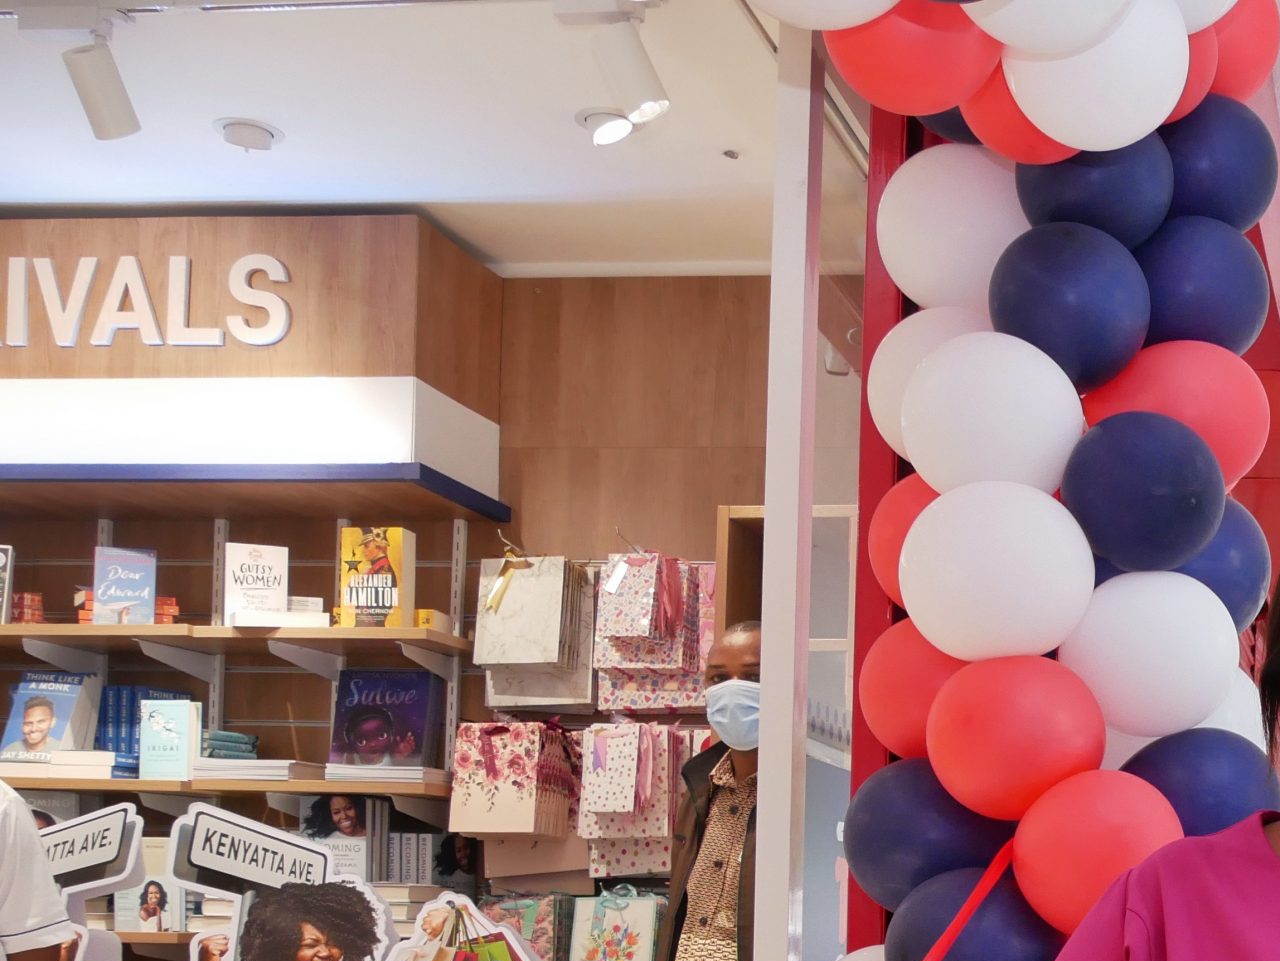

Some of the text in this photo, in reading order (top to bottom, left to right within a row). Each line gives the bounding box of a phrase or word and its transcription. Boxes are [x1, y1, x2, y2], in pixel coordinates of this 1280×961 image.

[0, 254, 291, 347] IVALS
[107, 565, 145, 581] Dear
[240, 562, 273, 575] GUTSY
[232, 569, 282, 588] WOMEN
[350, 573, 392, 588] ALEXANDER
[98, 581, 150, 600] Edward
[344, 587, 399, 607] HAMILTON
[26, 672, 81, 684] THINK LIKE
[38, 682, 71, 692] MONK
[79, 827, 113, 855] AVE.
[202, 828, 285, 875] KENYATTA
